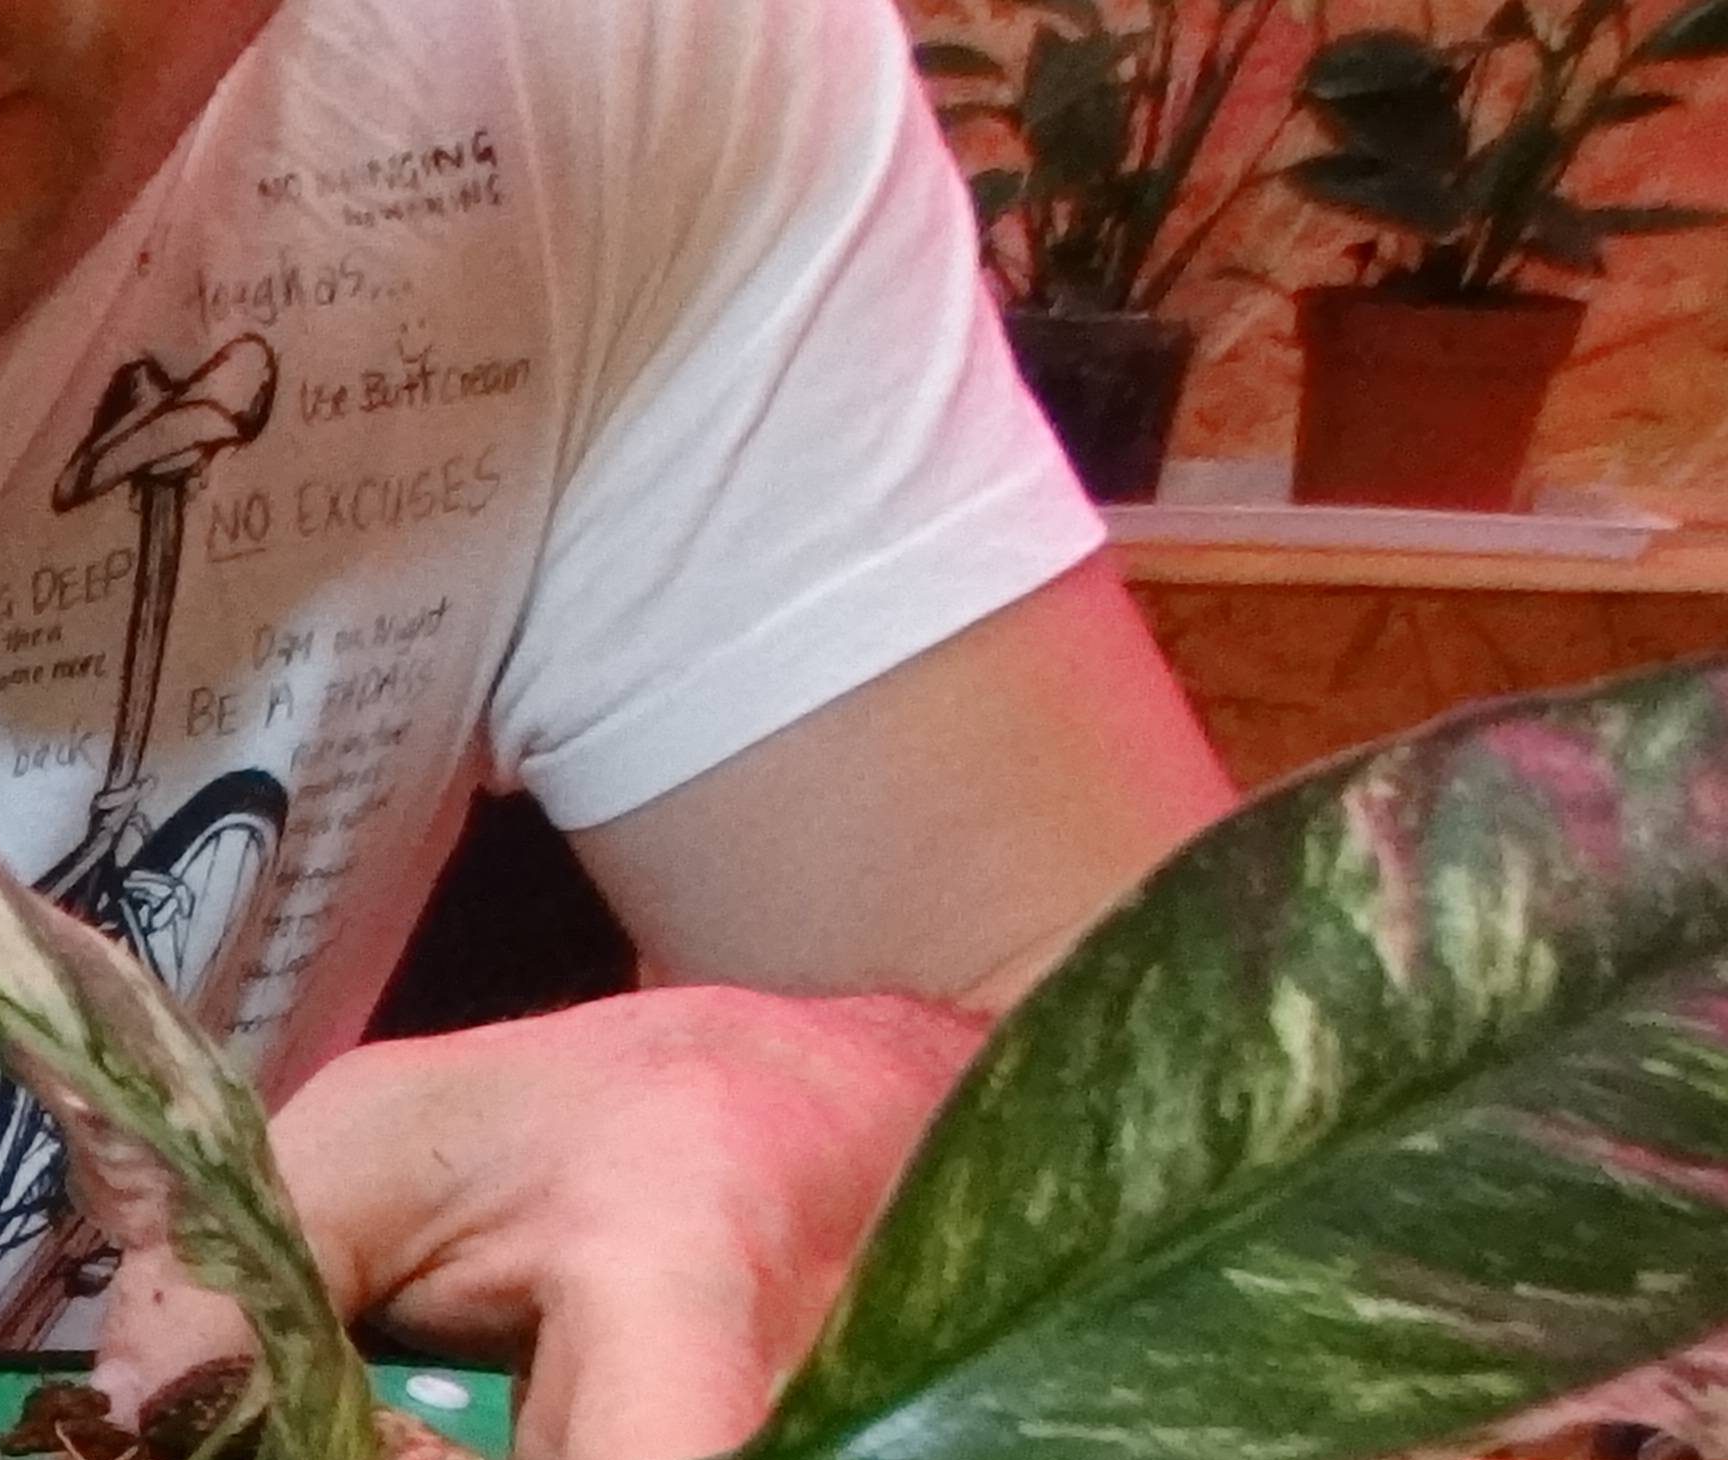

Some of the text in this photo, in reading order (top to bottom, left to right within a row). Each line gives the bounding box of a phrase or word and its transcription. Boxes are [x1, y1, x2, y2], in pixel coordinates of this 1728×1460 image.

[207, 442, 501, 550] NO EXCUSES
[32, 548, 134, 615] DEEP
[185, 686, 239, 739] BE
[265, 681, 296, 730] A
